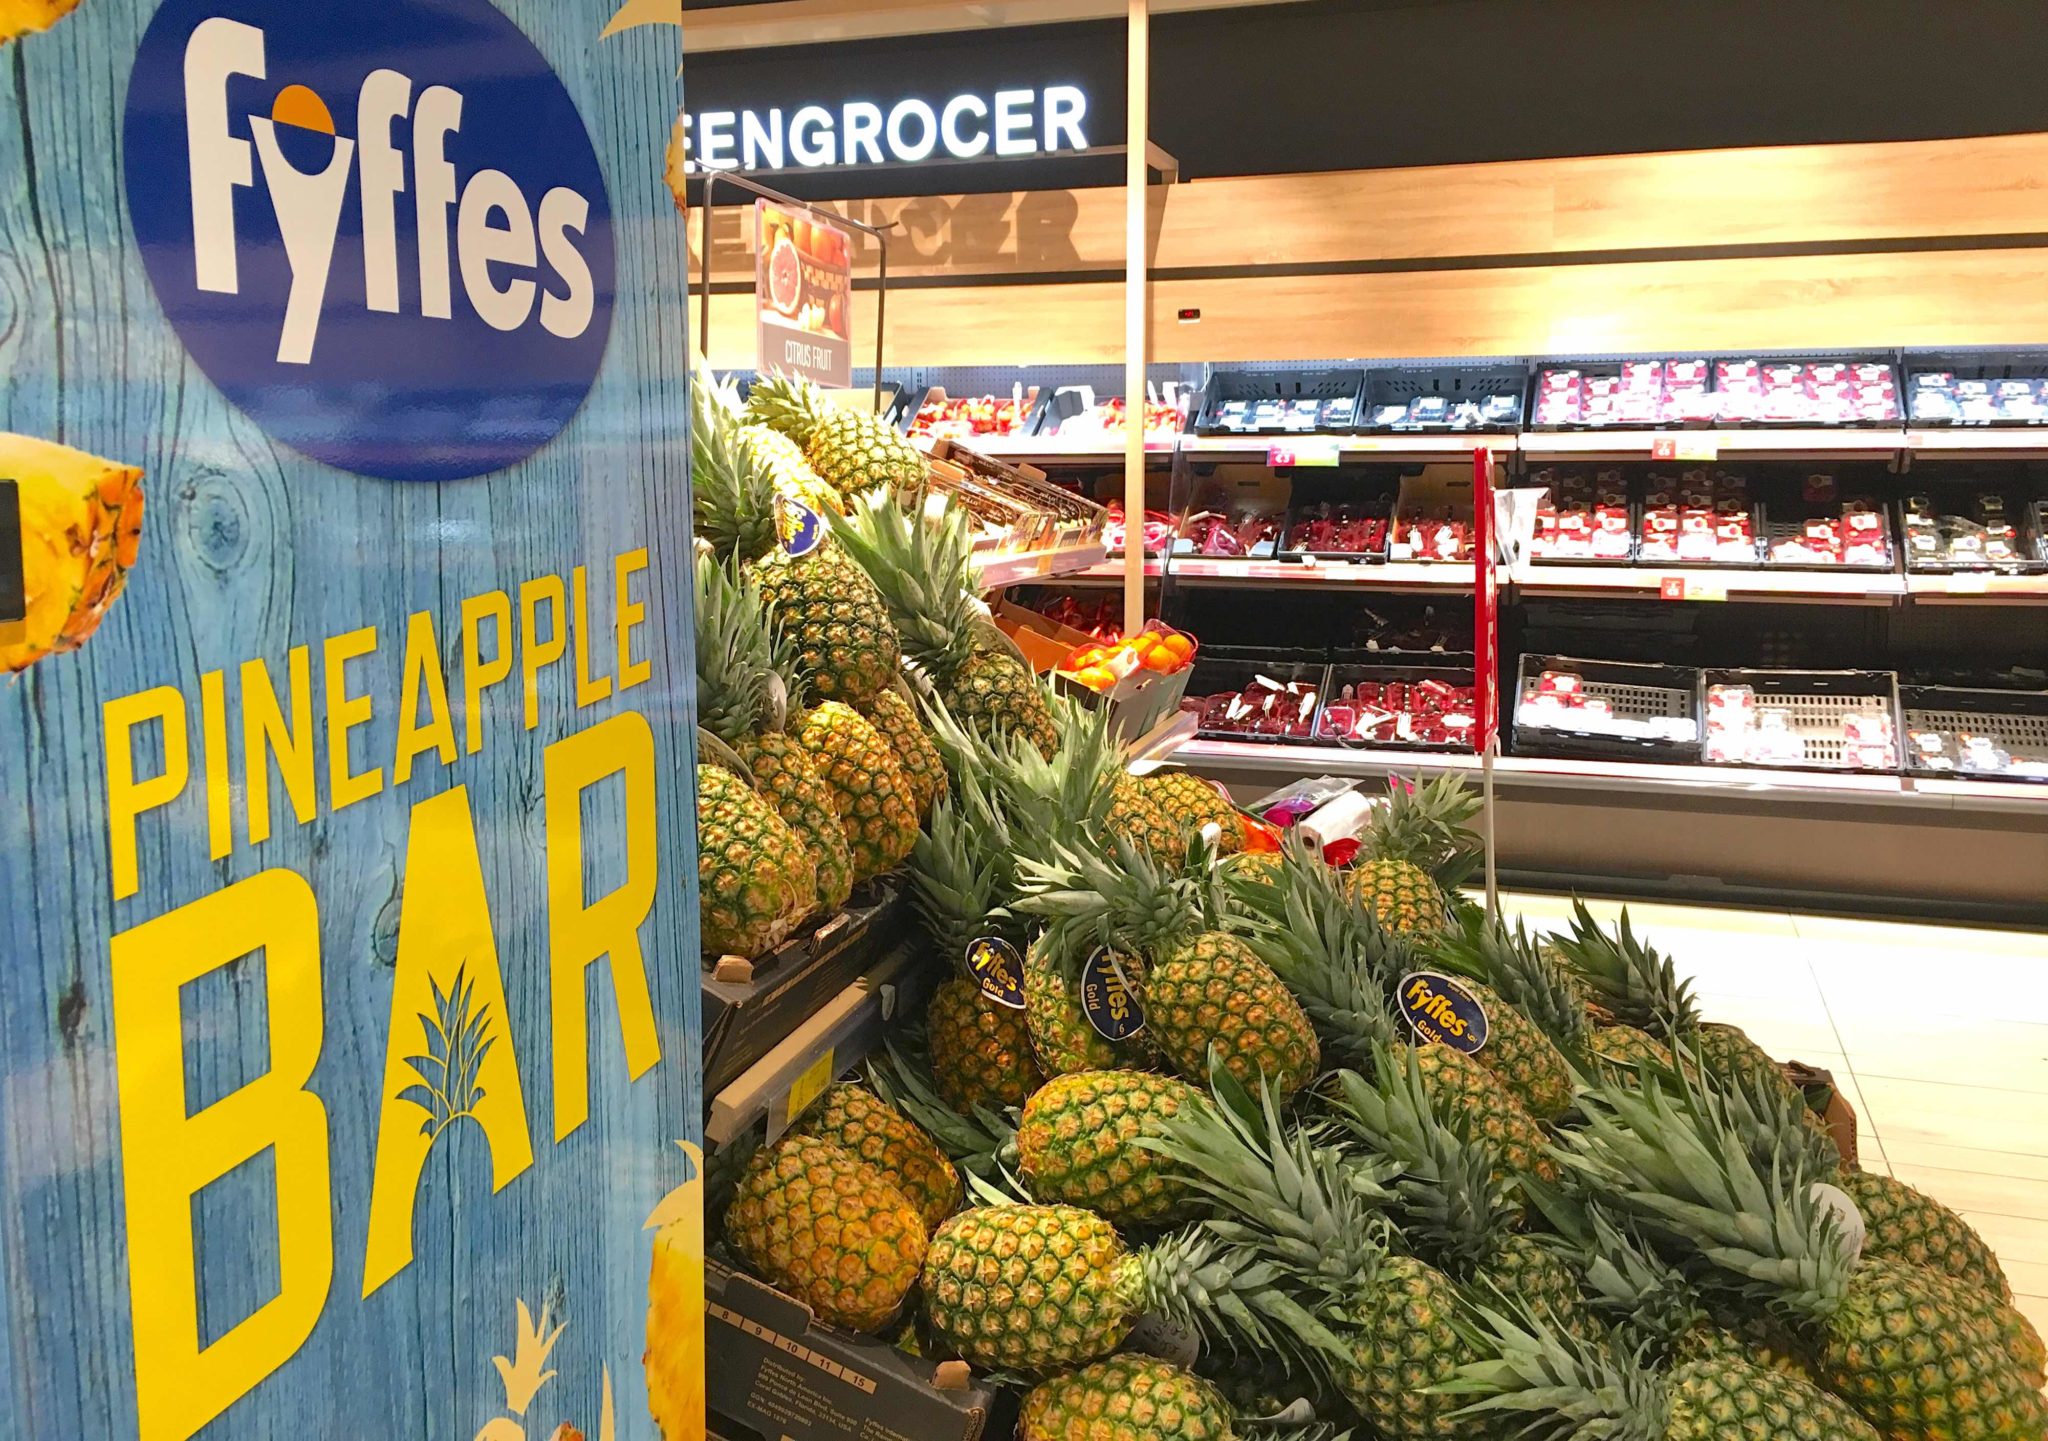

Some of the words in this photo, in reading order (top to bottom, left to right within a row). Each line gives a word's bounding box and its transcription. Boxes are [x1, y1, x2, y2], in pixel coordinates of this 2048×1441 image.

[785, 340, 811, 366] CITRUS
[812, 346, 832, 372] FRUIT
[103, 547, 652, 901] PINEAPPLE
[982, 977, 1004, 998] Gold
[1086, 983, 1101, 1011] Gold
[1417, 1020, 1442, 1043] Gold
[109, 711, 662, 1441] BAR
[722, 1310, 729, 1320] 8
[755, 1326, 762, 1335] 9
[786, 1342, 798, 1354] 10
[819, 1358, 831, 1370] 11
[853, 1375, 865, 1387] 15
